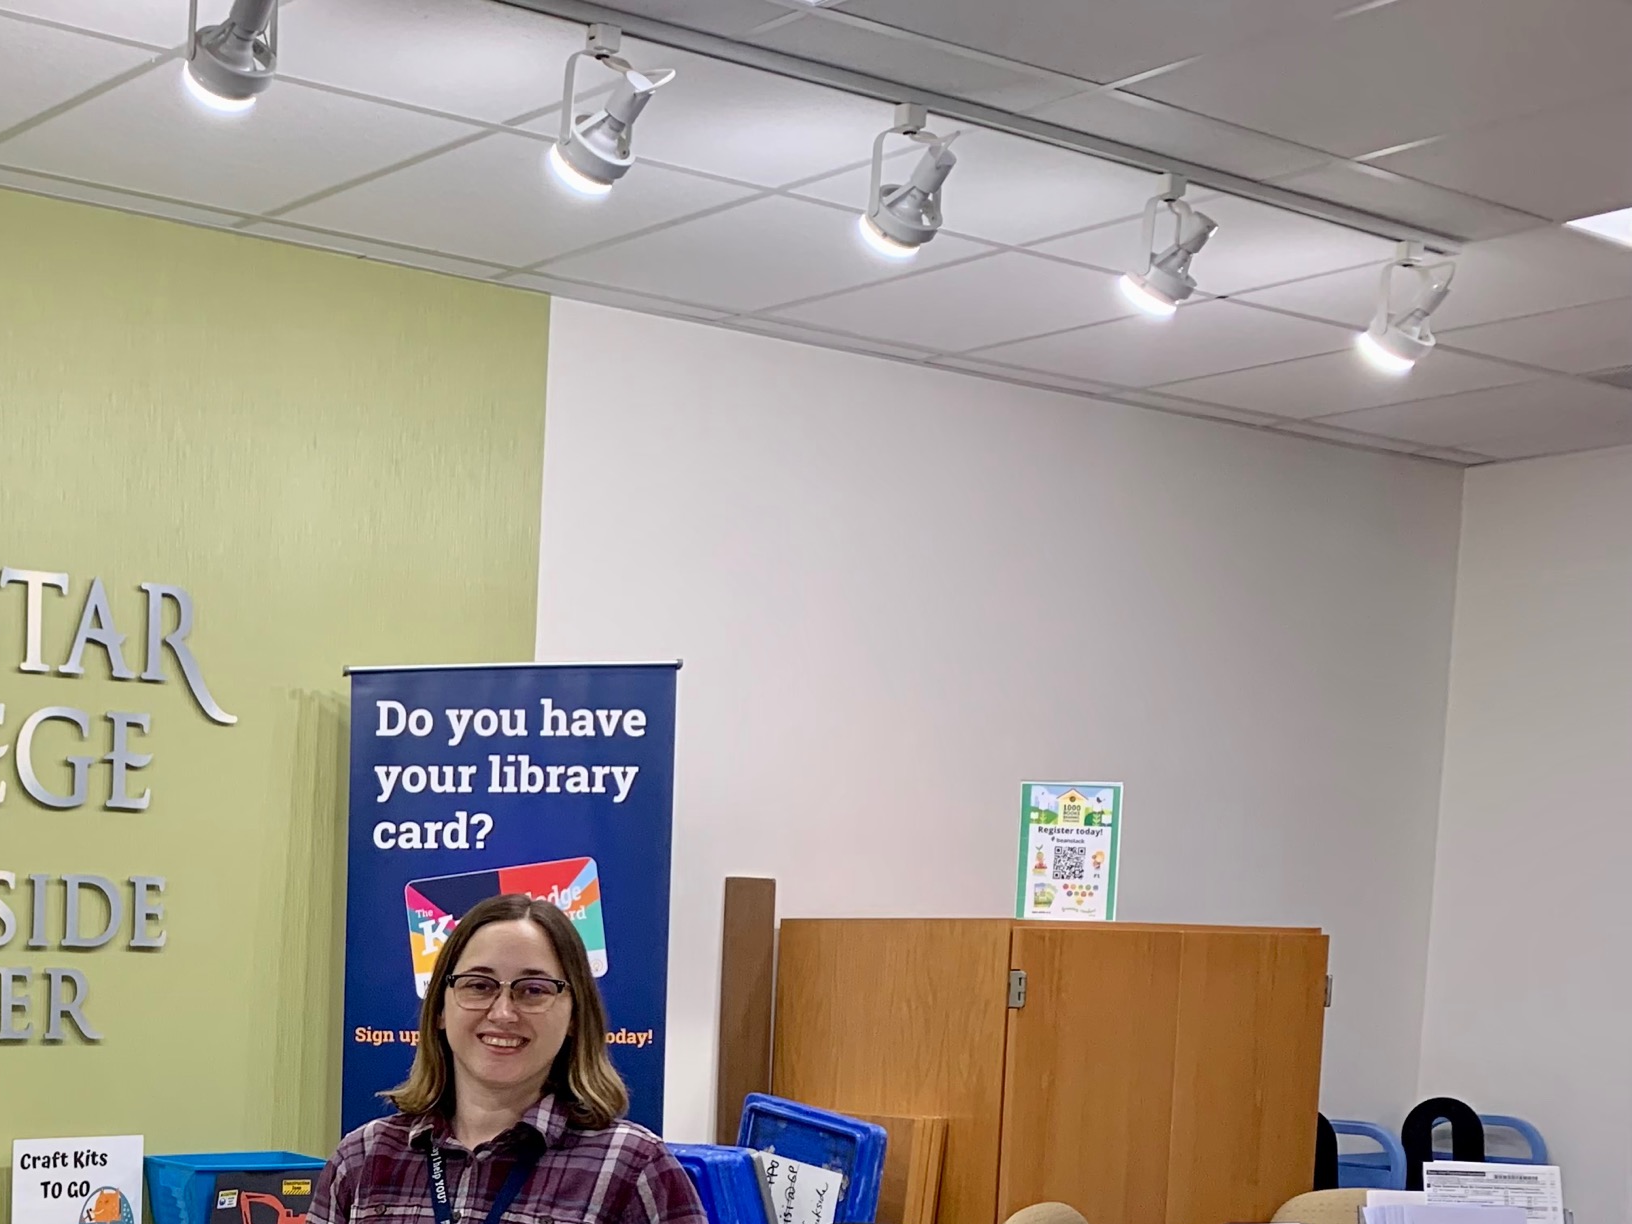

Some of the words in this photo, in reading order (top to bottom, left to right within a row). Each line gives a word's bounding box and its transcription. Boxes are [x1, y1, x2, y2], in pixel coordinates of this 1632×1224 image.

[375, 699, 434, 737] Do
[446, 707, 528, 746] you
[540, 698, 647, 738] have
[374, 764, 477, 803] your
[488, 754, 639, 803] library
[373, 811, 494, 850] card?
[1038, 826, 1074, 836] Register
[1076, 828, 1103, 837] today!
[415, 908, 434, 919] The
[355, 1025, 395, 1046] Sign
[399, 1030, 421, 1047] up
[605, 1027, 653, 1048] oday!
[20, 1150, 68, 1170] Craft
[73, 1149, 108, 1169] Kits
[431, 1160, 443, 1180] help
[41, 1181, 63, 1199] TO
[67, 1180, 90, 1198] GO
[434, 1179, 448, 1204] YOU?
